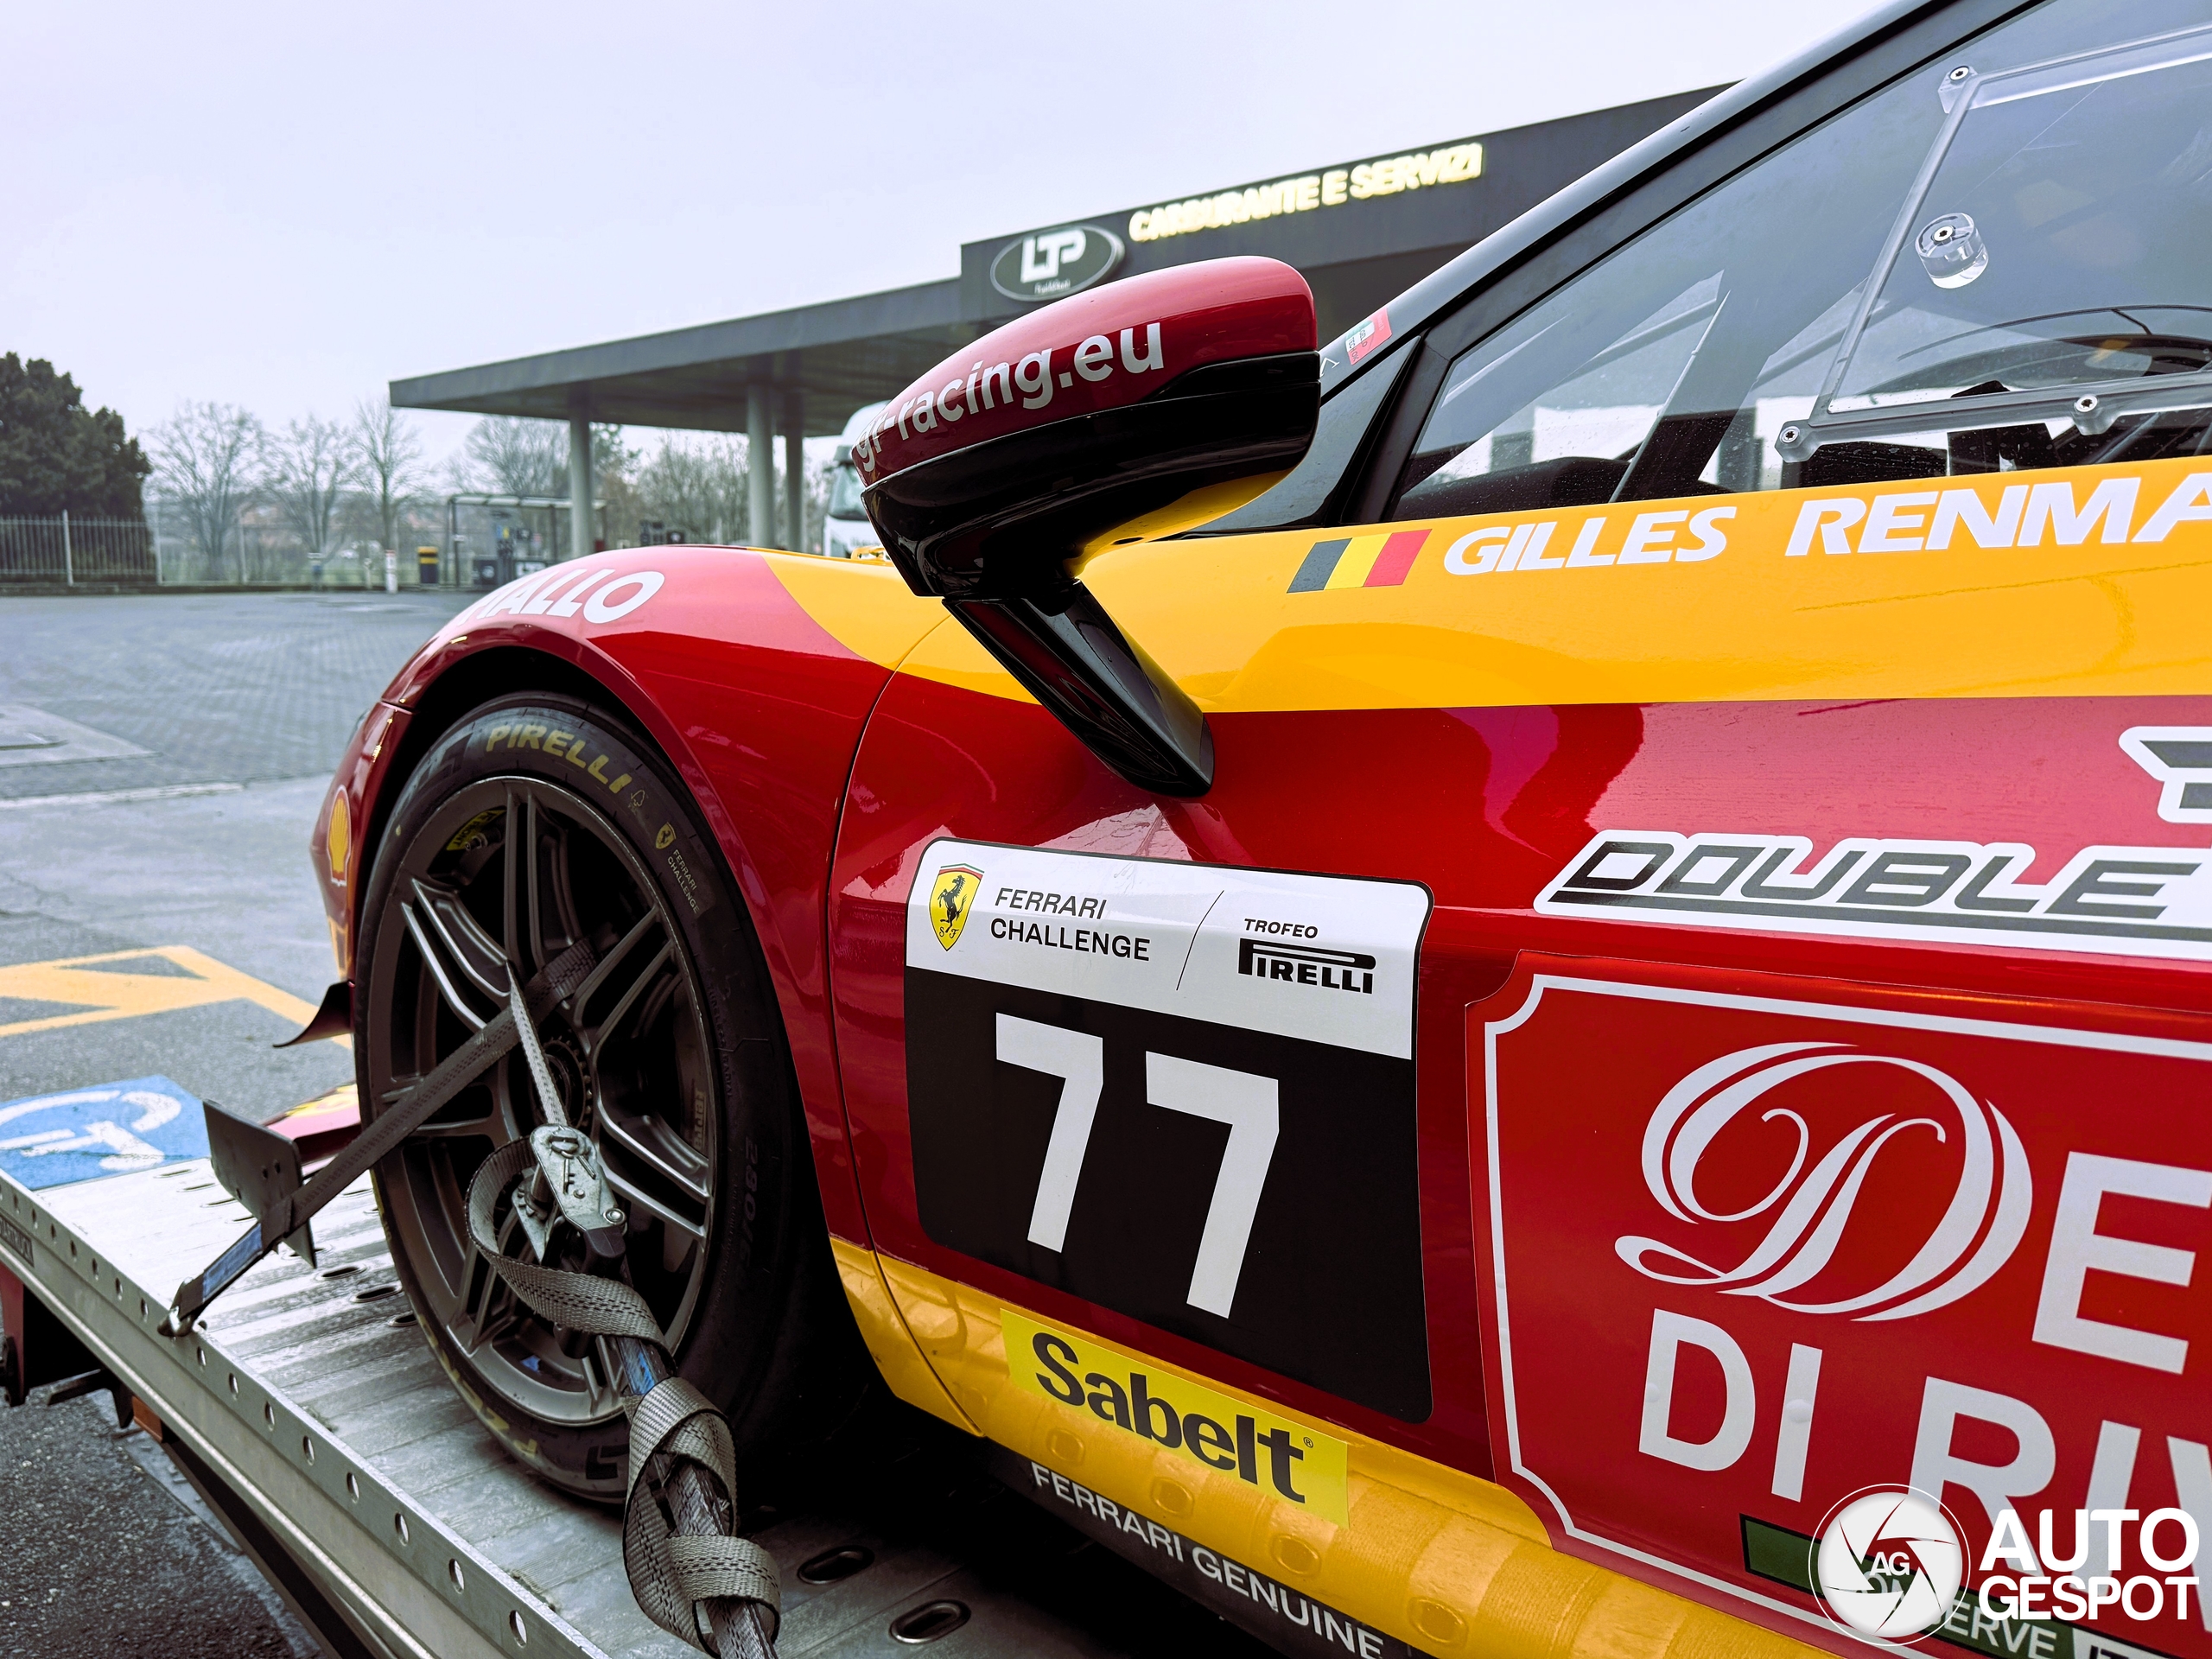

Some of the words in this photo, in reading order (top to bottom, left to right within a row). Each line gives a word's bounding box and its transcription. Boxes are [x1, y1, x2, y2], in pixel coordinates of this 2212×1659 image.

[1128, 175, 1320, 243] CARBURANTE
[1322, 170, 1348, 206] E
[1350, 143, 1484, 200] SERVIZI
[1020, 228, 1087, 283] LTP
[855, 322, 1165, 473] gr-racing.eu
[1443, 505, 1737, 576] GILLES
[1785, 473, 2212, 557] RENMA
[485, 724, 634, 793] PIRELLI
[667, 856, 699, 914] CHALLENGE
[673, 849, 697, 890] FERRARI
[994, 887, 1107, 920] FERRARI
[1560, 842, 2202, 919] DOUBLE
[990, 918, 1151, 962] CHALLENGE
[1243, 918, 1319, 939] TROFEO
[1237, 938, 1376, 995] PIRELLI
[995, 1012, 1280, 1319] 77
[1639, 1308, 1823, 1503] DI
[1031, 1460, 1184, 1563] FERRARI
[1192, 1545, 1384, 1659] GENUINE
